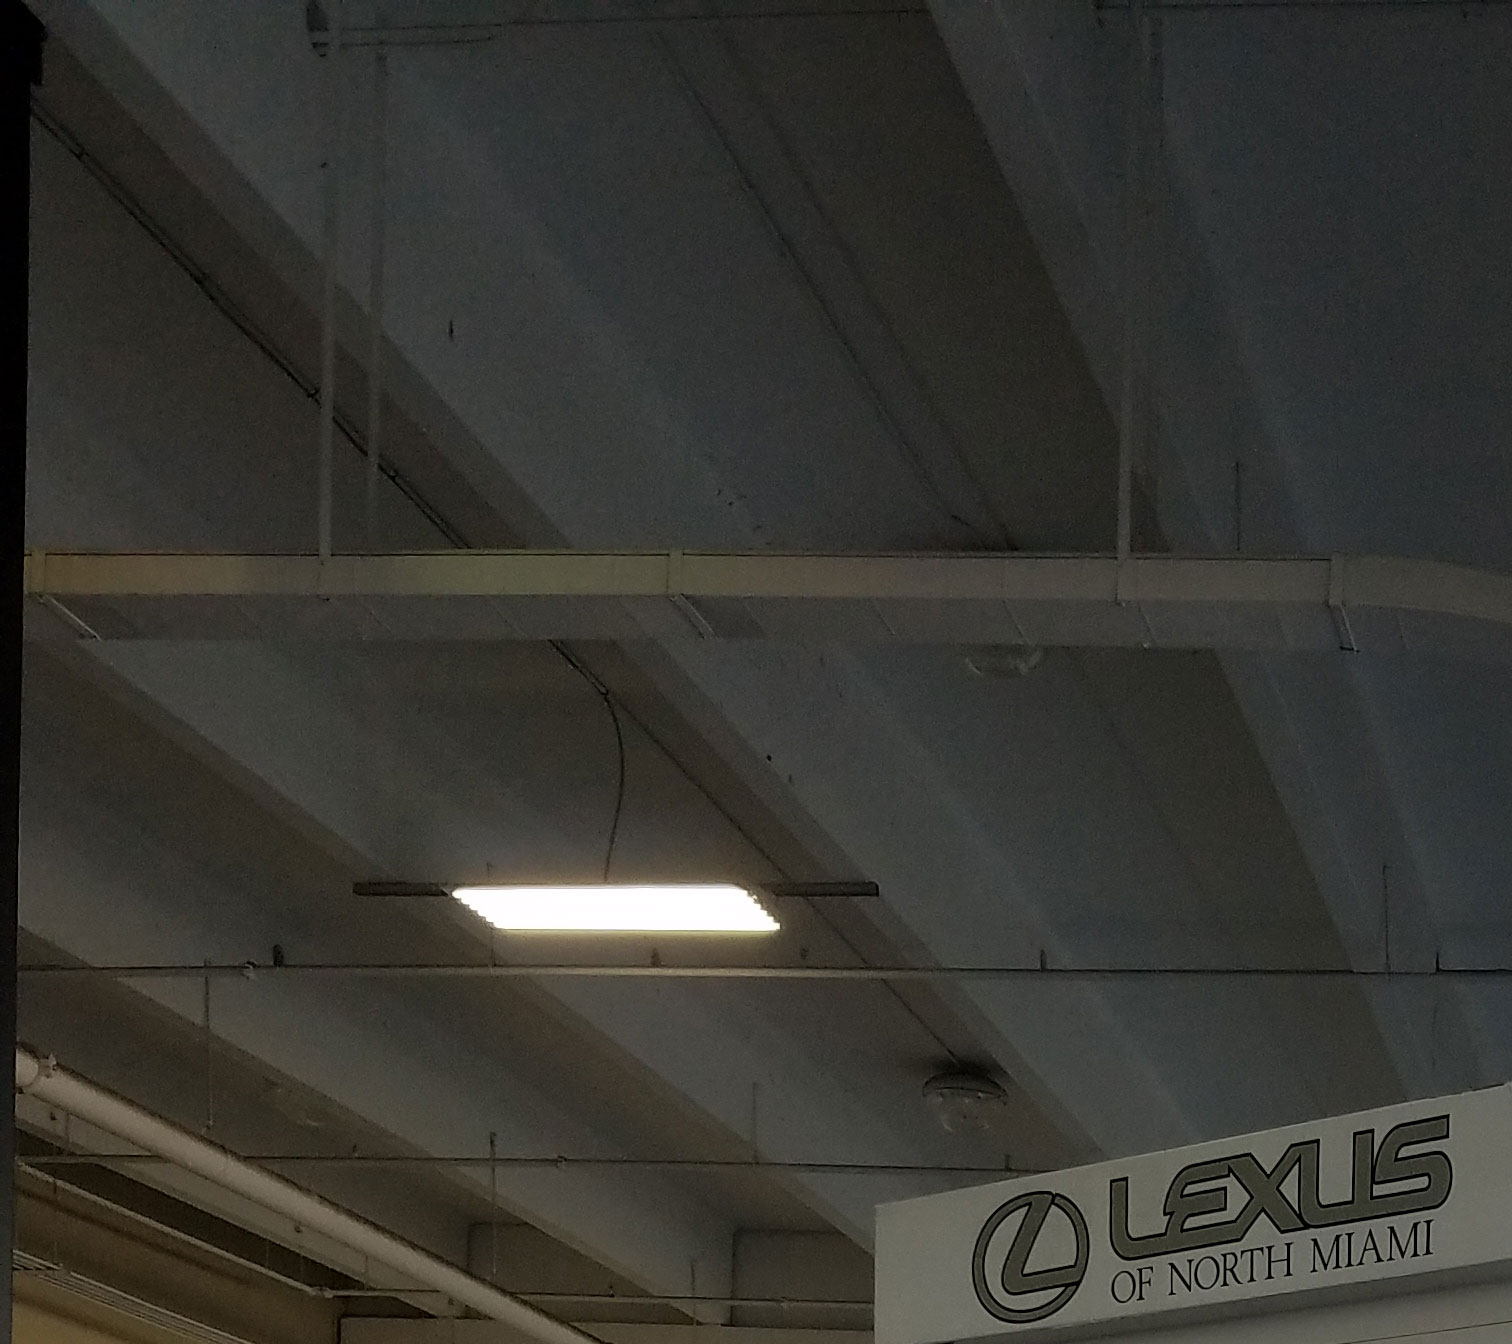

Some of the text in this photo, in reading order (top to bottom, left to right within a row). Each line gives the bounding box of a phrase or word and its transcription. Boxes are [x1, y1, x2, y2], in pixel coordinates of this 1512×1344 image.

[1110, 1113, 1453, 1261] LEXUS
[1111, 1220, 1435, 1304] OF NORTH MIAMI
